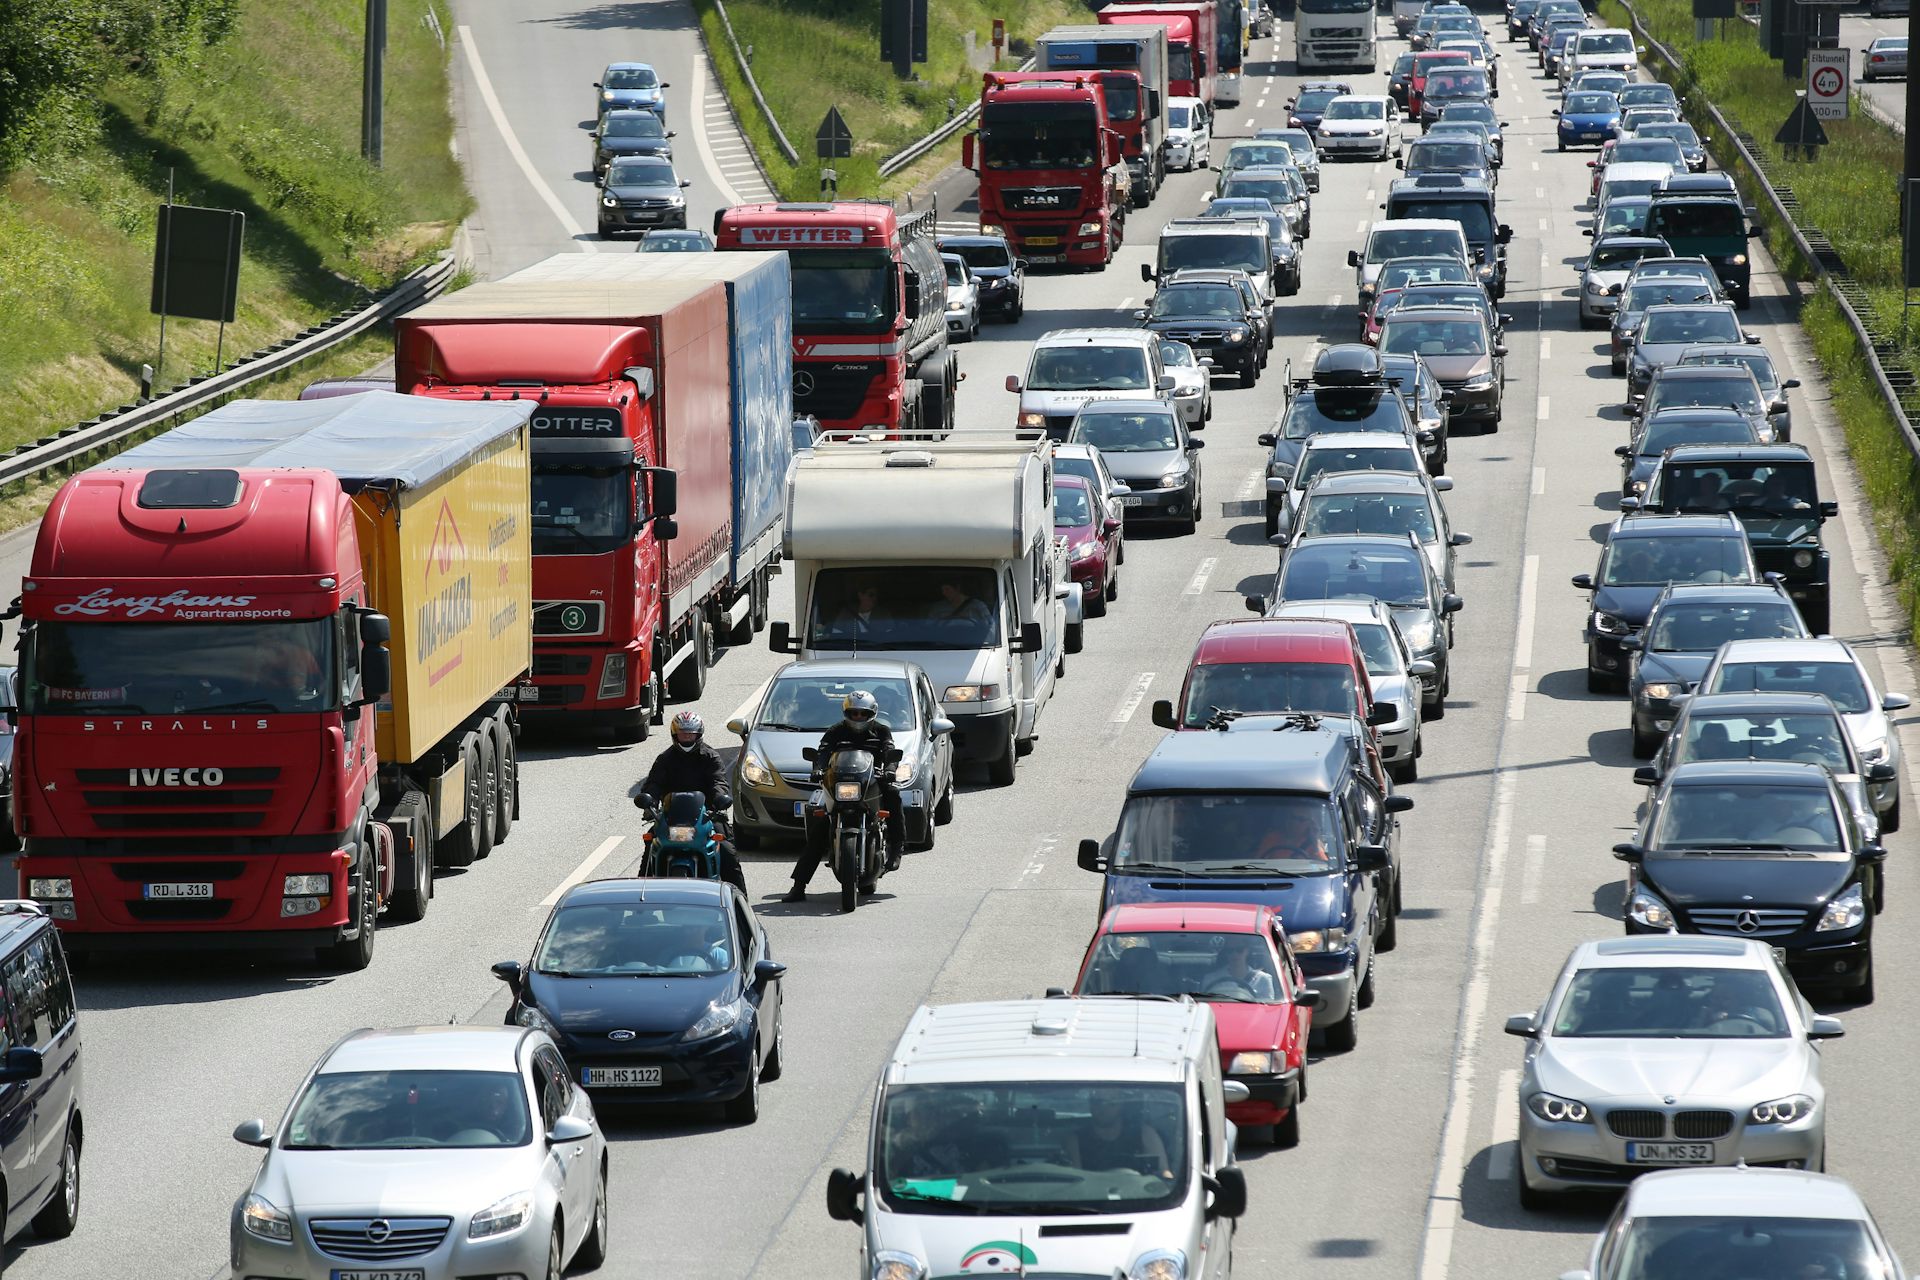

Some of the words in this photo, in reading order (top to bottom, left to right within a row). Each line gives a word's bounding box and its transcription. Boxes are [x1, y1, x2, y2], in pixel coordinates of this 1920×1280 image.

[1812, 54, 1845, 63] Elbtunnel
[1818, 76, 1826, 87] 4
[1023, 196, 1059, 205] MAN
[752, 229, 853, 242] WETTER
[53, 587, 257, 617] Langhans
[174, 608, 291, 620] Agrartransporte
[568, 611, 579, 626] 3
[61, 689, 73, 700] FC
[74, 690, 110, 700] BAYERN
[84, 719, 268, 731] STRALIS
[129, 767, 224, 787] IVECO
[153, 885, 169, 896] RD
[176, 885, 184, 896] L
[187, 884, 208, 896] 318
[590, 1070, 605, 1083] HH
[613, 1070, 628, 1083] HS
[631, 1069, 659, 1082] 1122
[1640, 1145, 1659, 1158] UN
[1668, 1145, 1686, 1158] MS
[1689, 1145, 1707, 1158] 32
